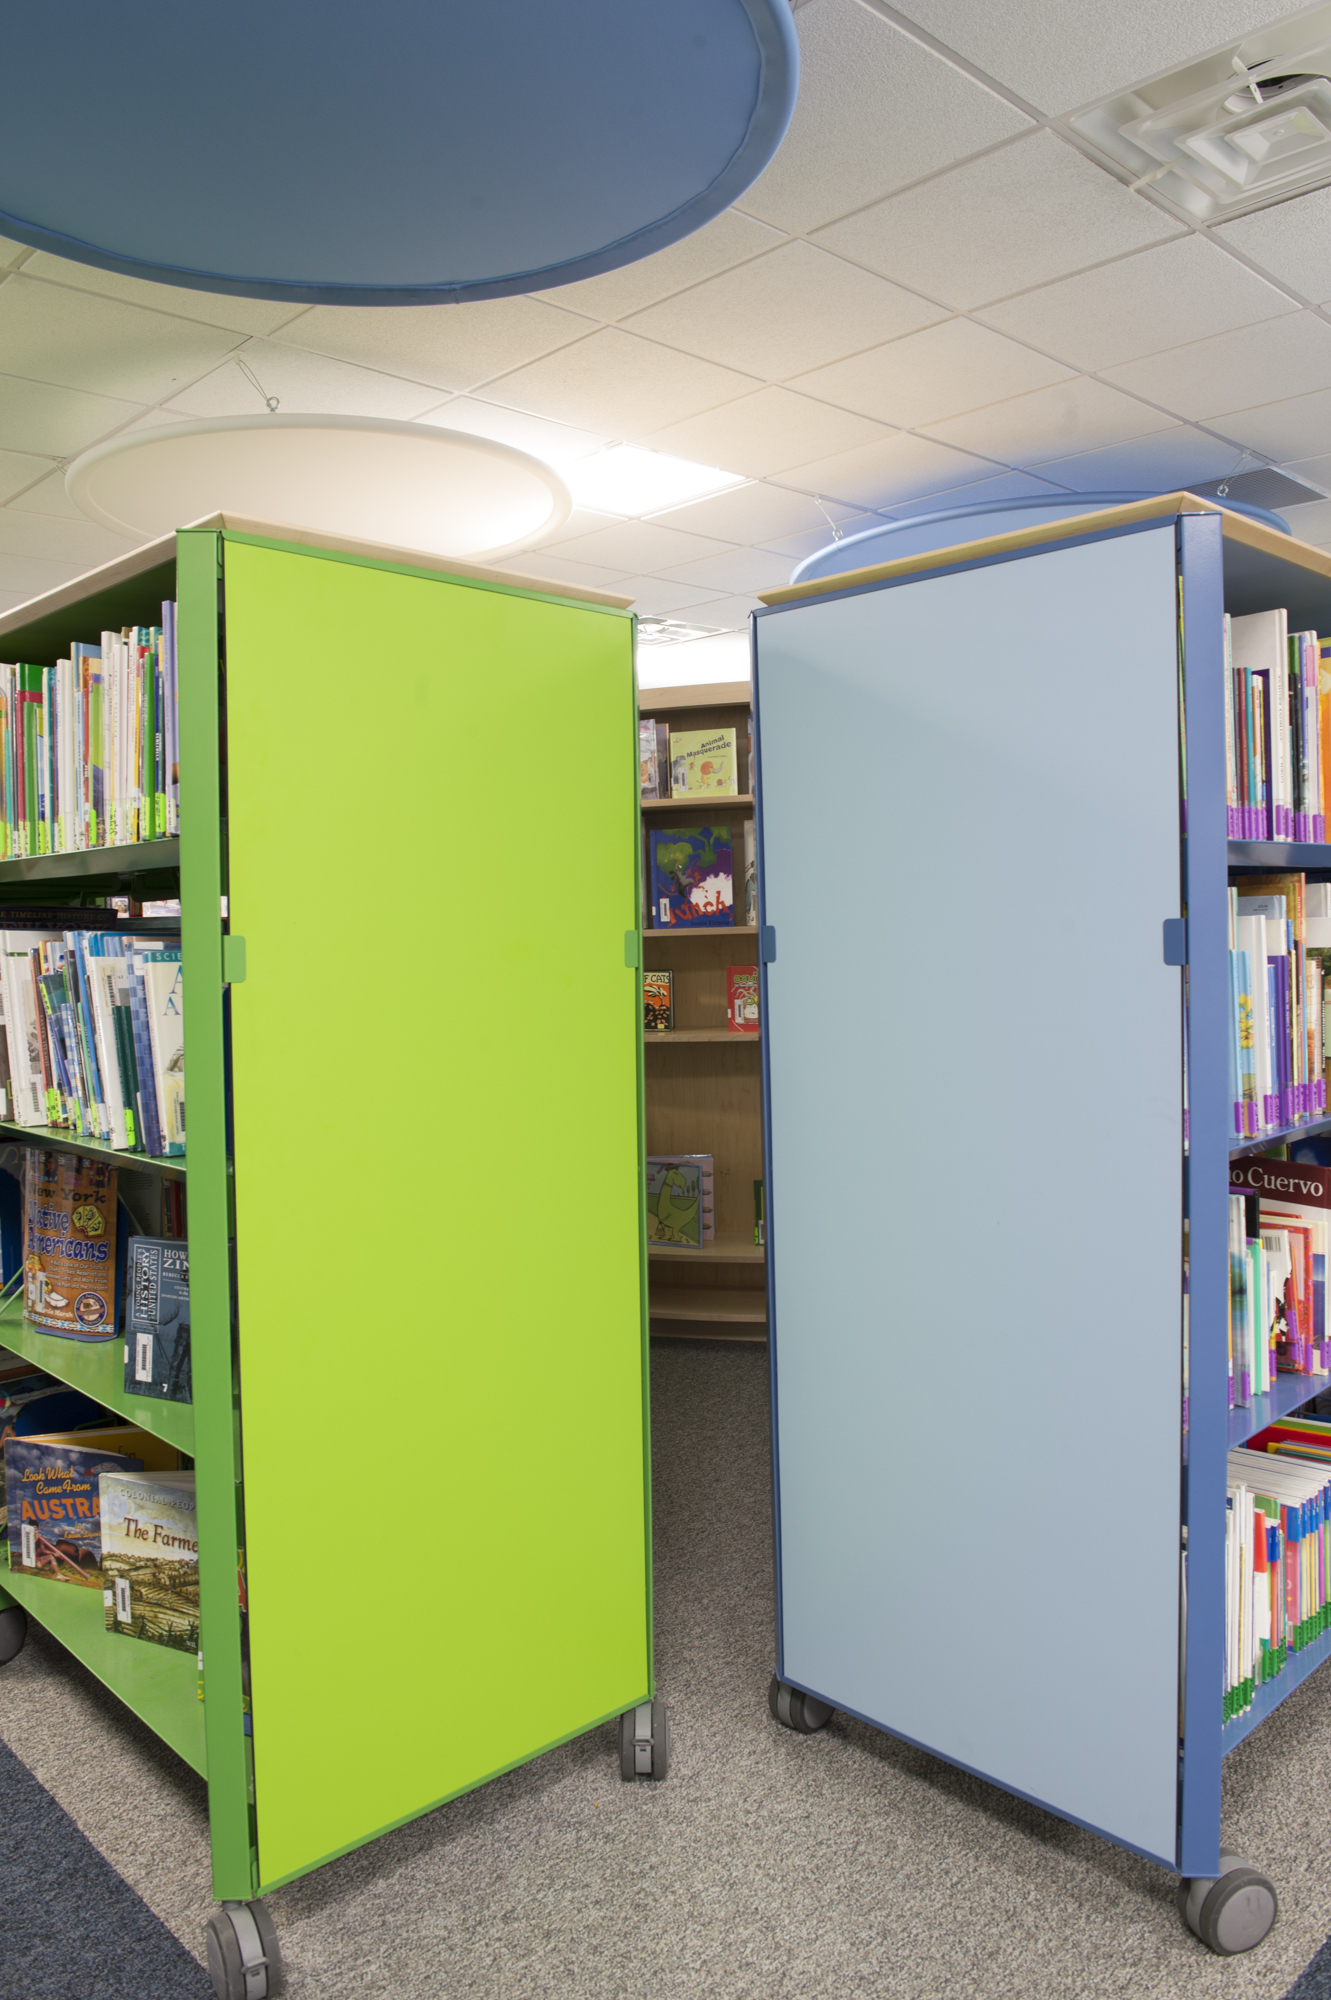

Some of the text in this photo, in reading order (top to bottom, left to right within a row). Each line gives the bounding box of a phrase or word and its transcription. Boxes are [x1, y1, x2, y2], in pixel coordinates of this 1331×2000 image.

[686, 741, 732, 757] Masquerade
[700, 734, 725, 749] Animal
[10, 911, 54, 919] TIMELINE
[56, 912, 95, 920] HISTORY
[651, 974, 670, 985] CATS
[1247, 1166, 1324, 1197] Cuervo
[28, 1183, 107, 1204] New York
[28, 1199, 70, 1231] Native
[27, 1226, 109, 1263] Americans
[163, 1249, 189, 1260] HOW
[149, 1249, 158, 1281] STATES
[140, 1249, 150, 1318] HISTORY
[148, 1282, 157, 1315] UNITED
[162, 1383, 168, 1393] 7
[21, 1465, 74, 1482] Look What
[35, 1479, 91, 1495] Came From
[120, 1488, 167, 1506] COLONIAL
[64, 1530, 81, 1539] Kevin
[74, 1521, 82, 1533] by
[124, 1517, 199, 1553] The Farme
